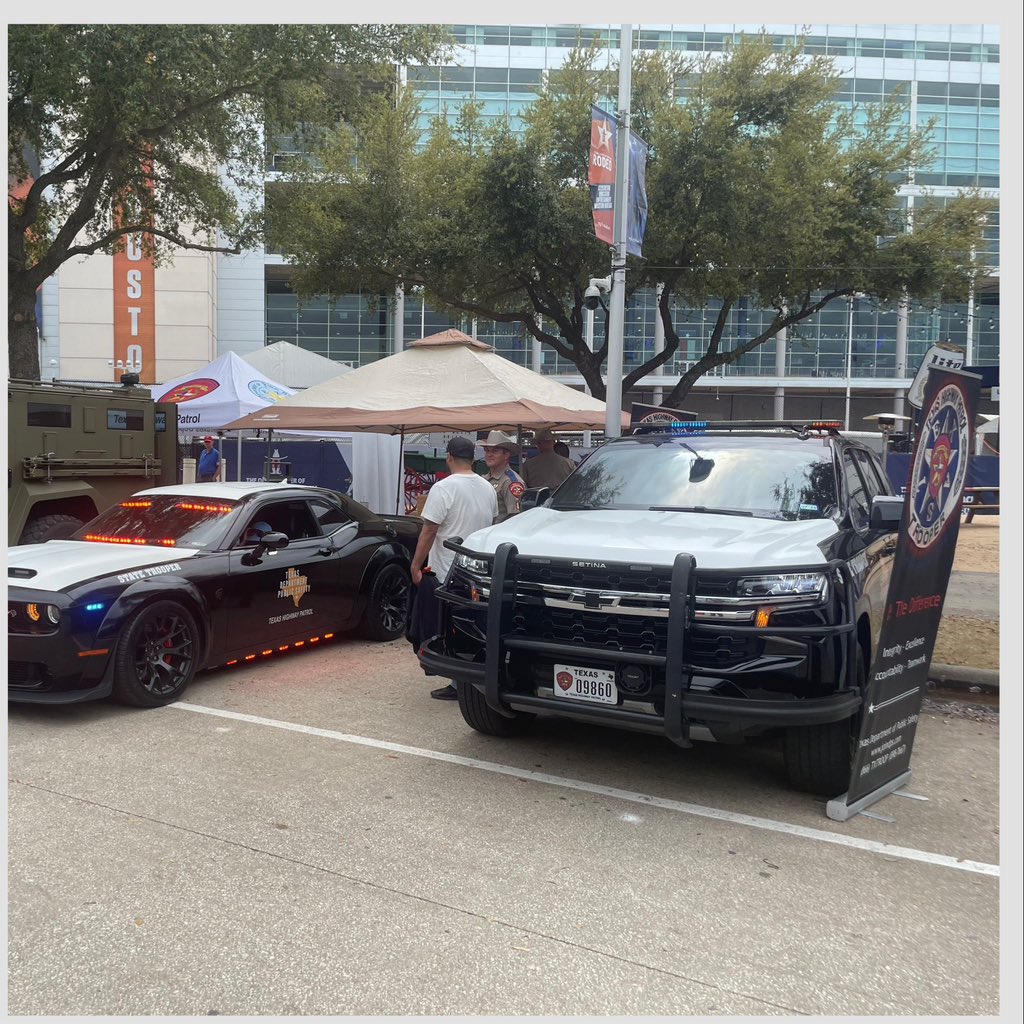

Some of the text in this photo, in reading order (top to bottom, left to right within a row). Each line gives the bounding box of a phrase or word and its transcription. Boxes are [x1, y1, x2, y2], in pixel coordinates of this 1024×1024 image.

[592, 154, 613, 171] RODEO
[176, 413, 201, 424] Patrol
[909, 512, 945, 545] TROOPER
[572, 561, 607, 569] SETINA
[117, 563, 182, 584] STATE TROOPER
[268, 615, 282, 625] TEXAS
[282, 611, 300, 622] HIGHWAY
[574, 669, 599, 679] TEXAS
[576, 679, 612, 698] 09860
